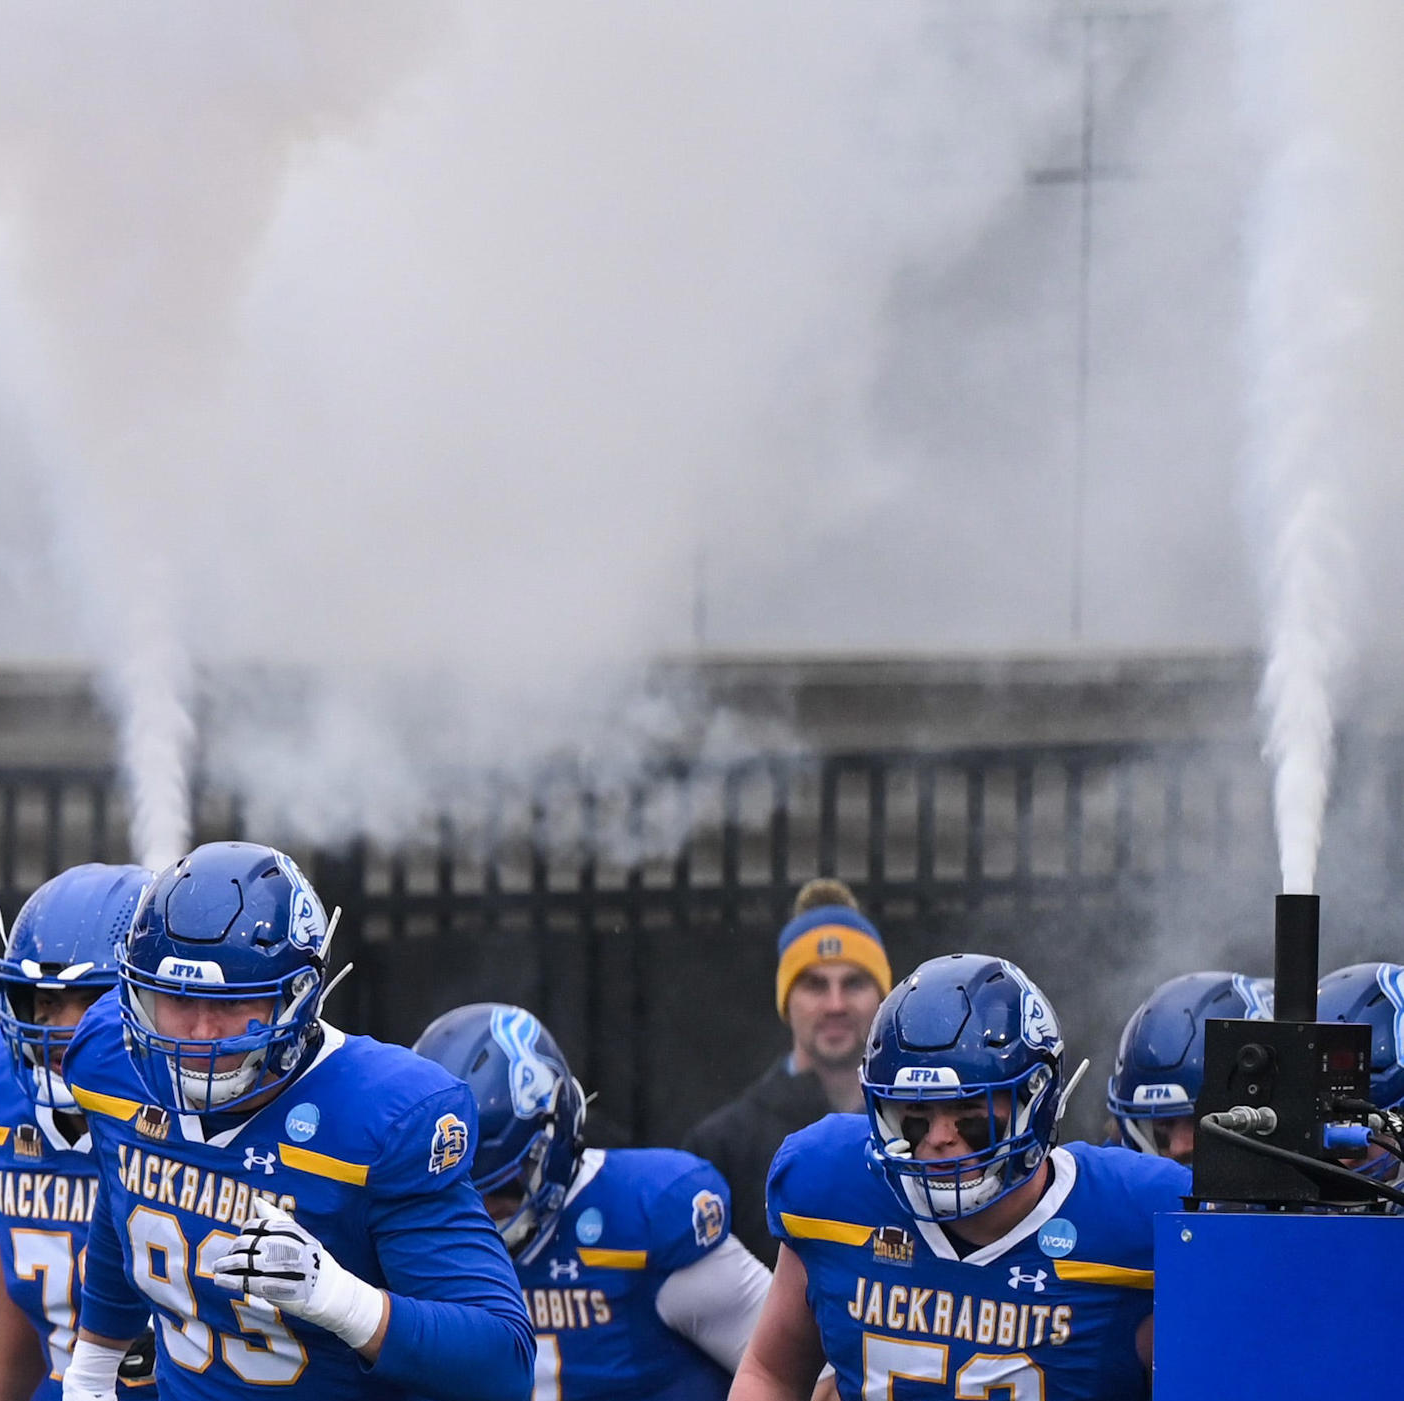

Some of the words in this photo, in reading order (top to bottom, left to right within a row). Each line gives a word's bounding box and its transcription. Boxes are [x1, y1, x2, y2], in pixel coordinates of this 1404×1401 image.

[169, 963, 203, 979] JFPA
[906, 1069, 941, 1083] JFPA
[1041, 1234, 1074, 1251] NCAA
[127, 1205, 309, 1386] 93
[848, 1277, 1073, 1349] JACKRABBITS
